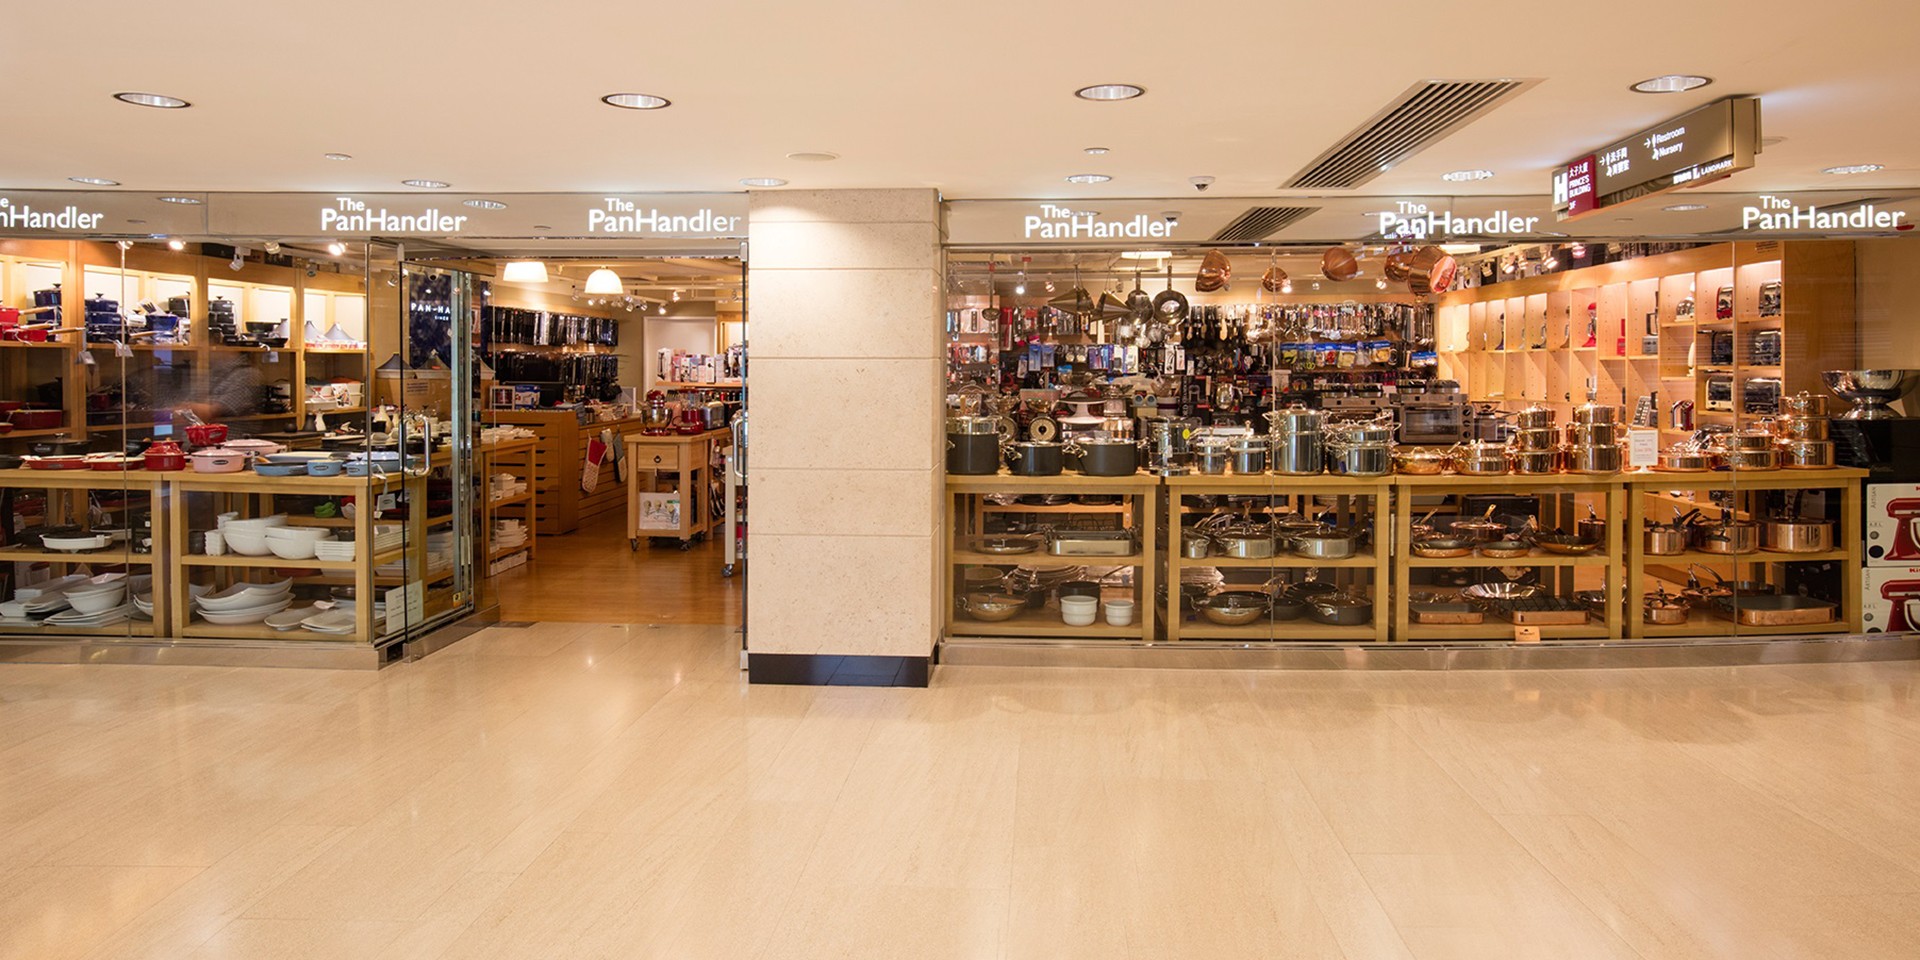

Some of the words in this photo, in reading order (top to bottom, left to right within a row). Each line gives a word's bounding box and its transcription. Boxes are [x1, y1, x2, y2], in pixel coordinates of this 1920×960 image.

[1656, 126, 1685, 144] Restroom
[1658, 142, 1683, 157] Nursery
[1700, 159, 1732, 175] LANDMARK
[1554, 171, 1568, 205] H
[1569, 183, 1591, 198] BUILDING
[336, 197, 365, 212] The
[604, 197, 634, 212] The
[1396, 200, 1427, 215] The
[1759, 195, 1791, 210] The
[1040, 203, 1071, 219] The
[1743, 205, 1906, 230] PanHandler
[321, 207, 467, 232] PanHandler
[588, 208, 742, 233] PanHandler
[1024, 212, 1178, 238] PanHandler
[1379, 210, 1539, 235] PanHandler
